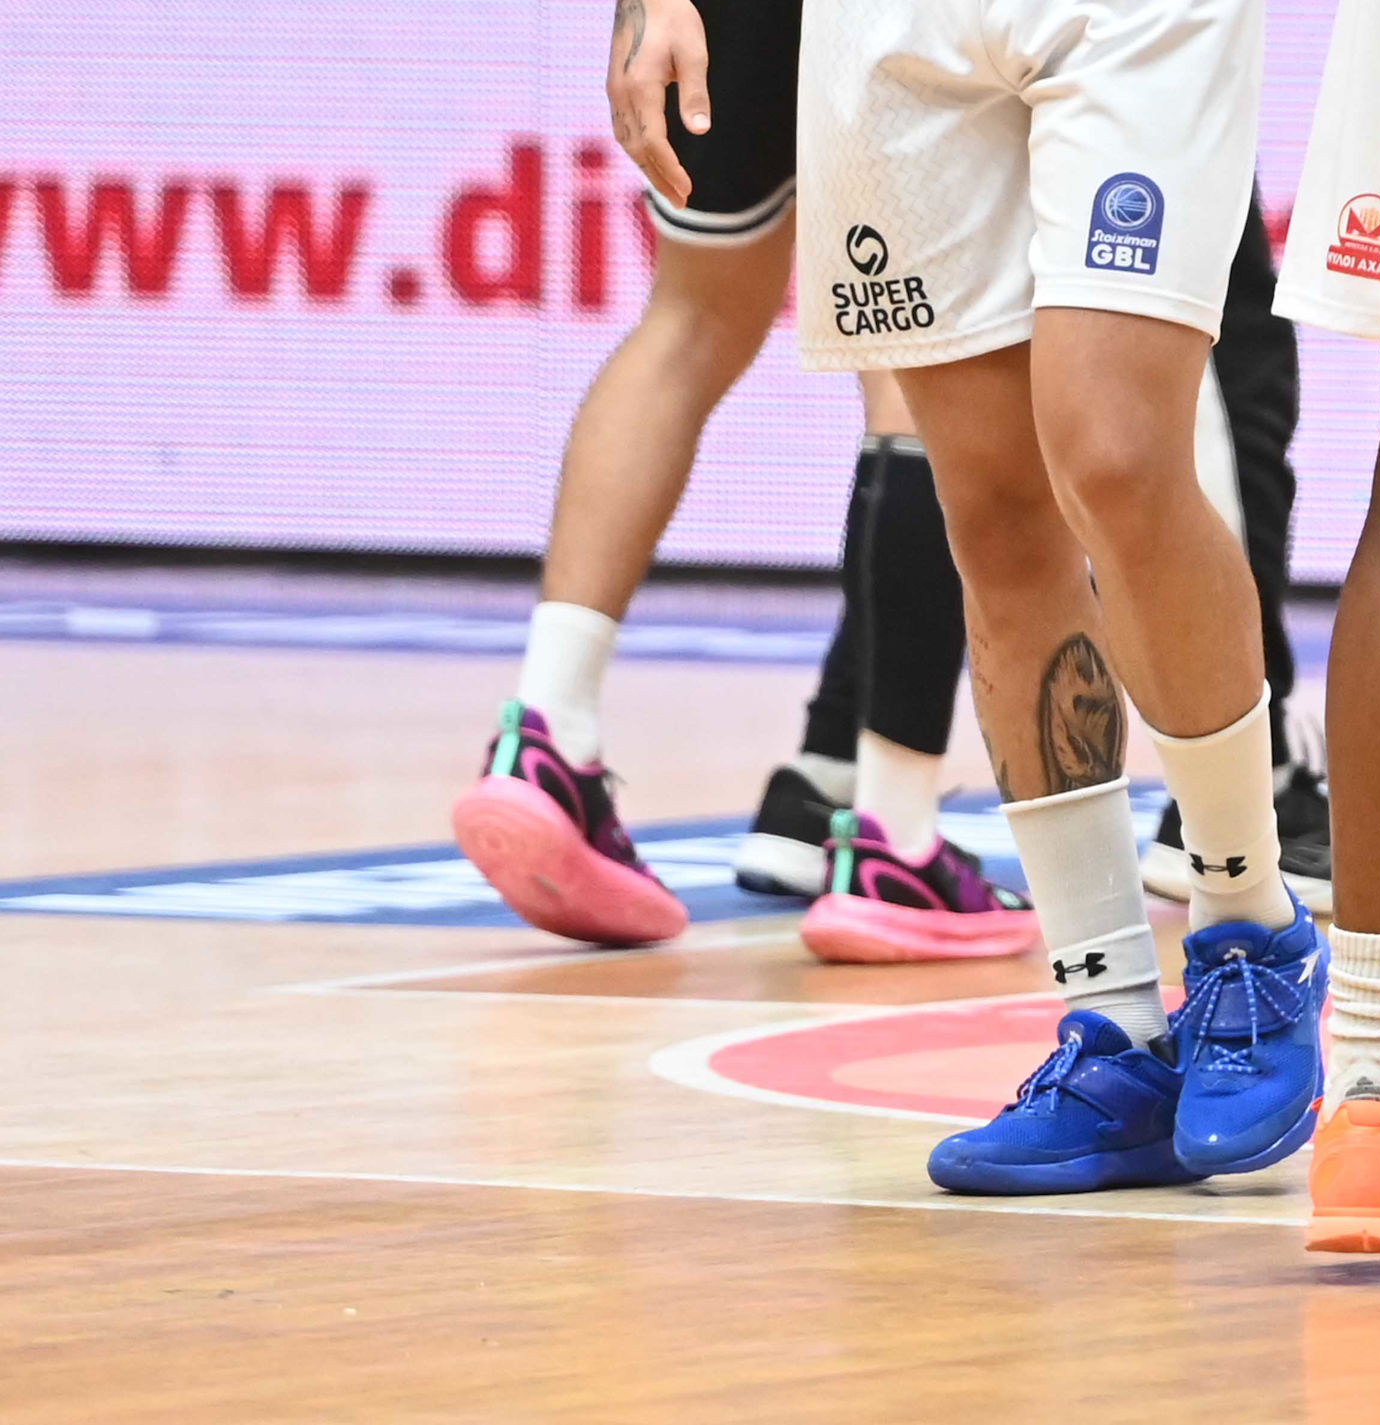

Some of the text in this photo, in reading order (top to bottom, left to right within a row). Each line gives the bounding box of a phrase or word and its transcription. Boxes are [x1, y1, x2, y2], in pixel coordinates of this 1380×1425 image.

[1091, 229, 1157, 248] Stoiximan
[1091, 243, 1151, 270] GBL
[832, 276, 928, 309] SUPER
[836, 303, 935, 336] CARGO
